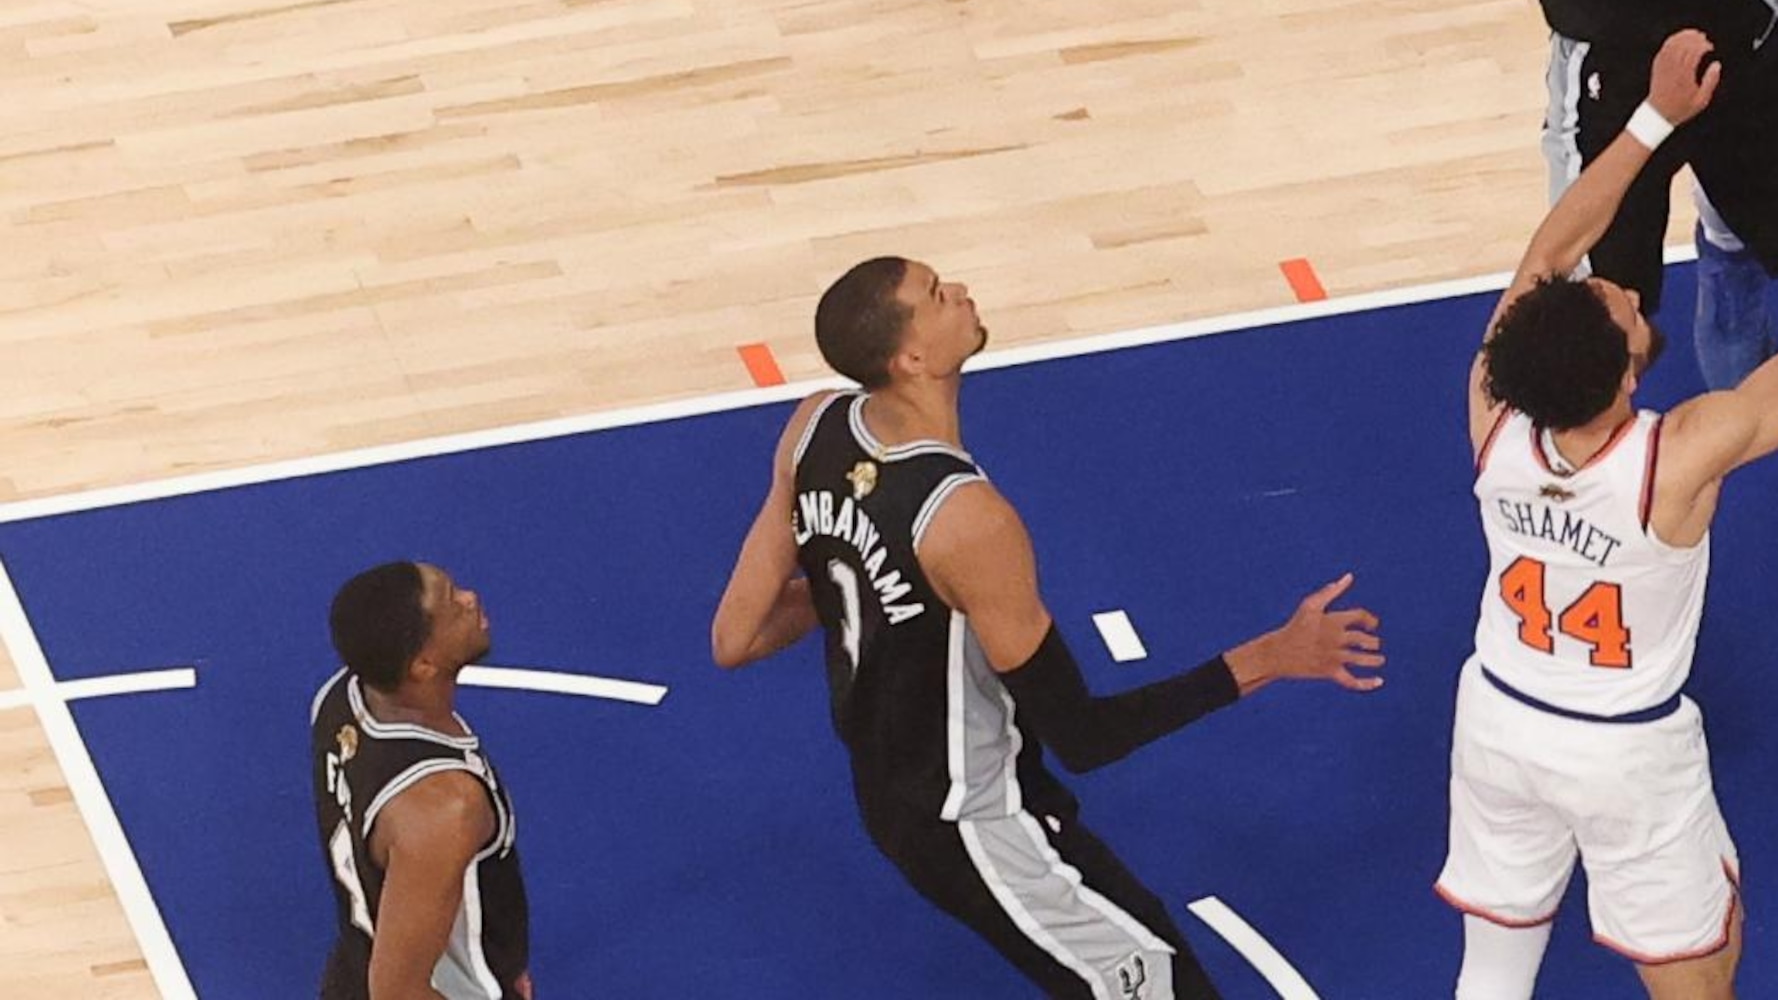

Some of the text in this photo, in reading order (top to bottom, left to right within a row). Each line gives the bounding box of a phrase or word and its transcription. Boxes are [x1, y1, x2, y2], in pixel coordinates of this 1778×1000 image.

[1498, 498, 1621, 567] SHAMET
[827, 557, 862, 683] 1
[1499, 554, 1632, 669] 44
